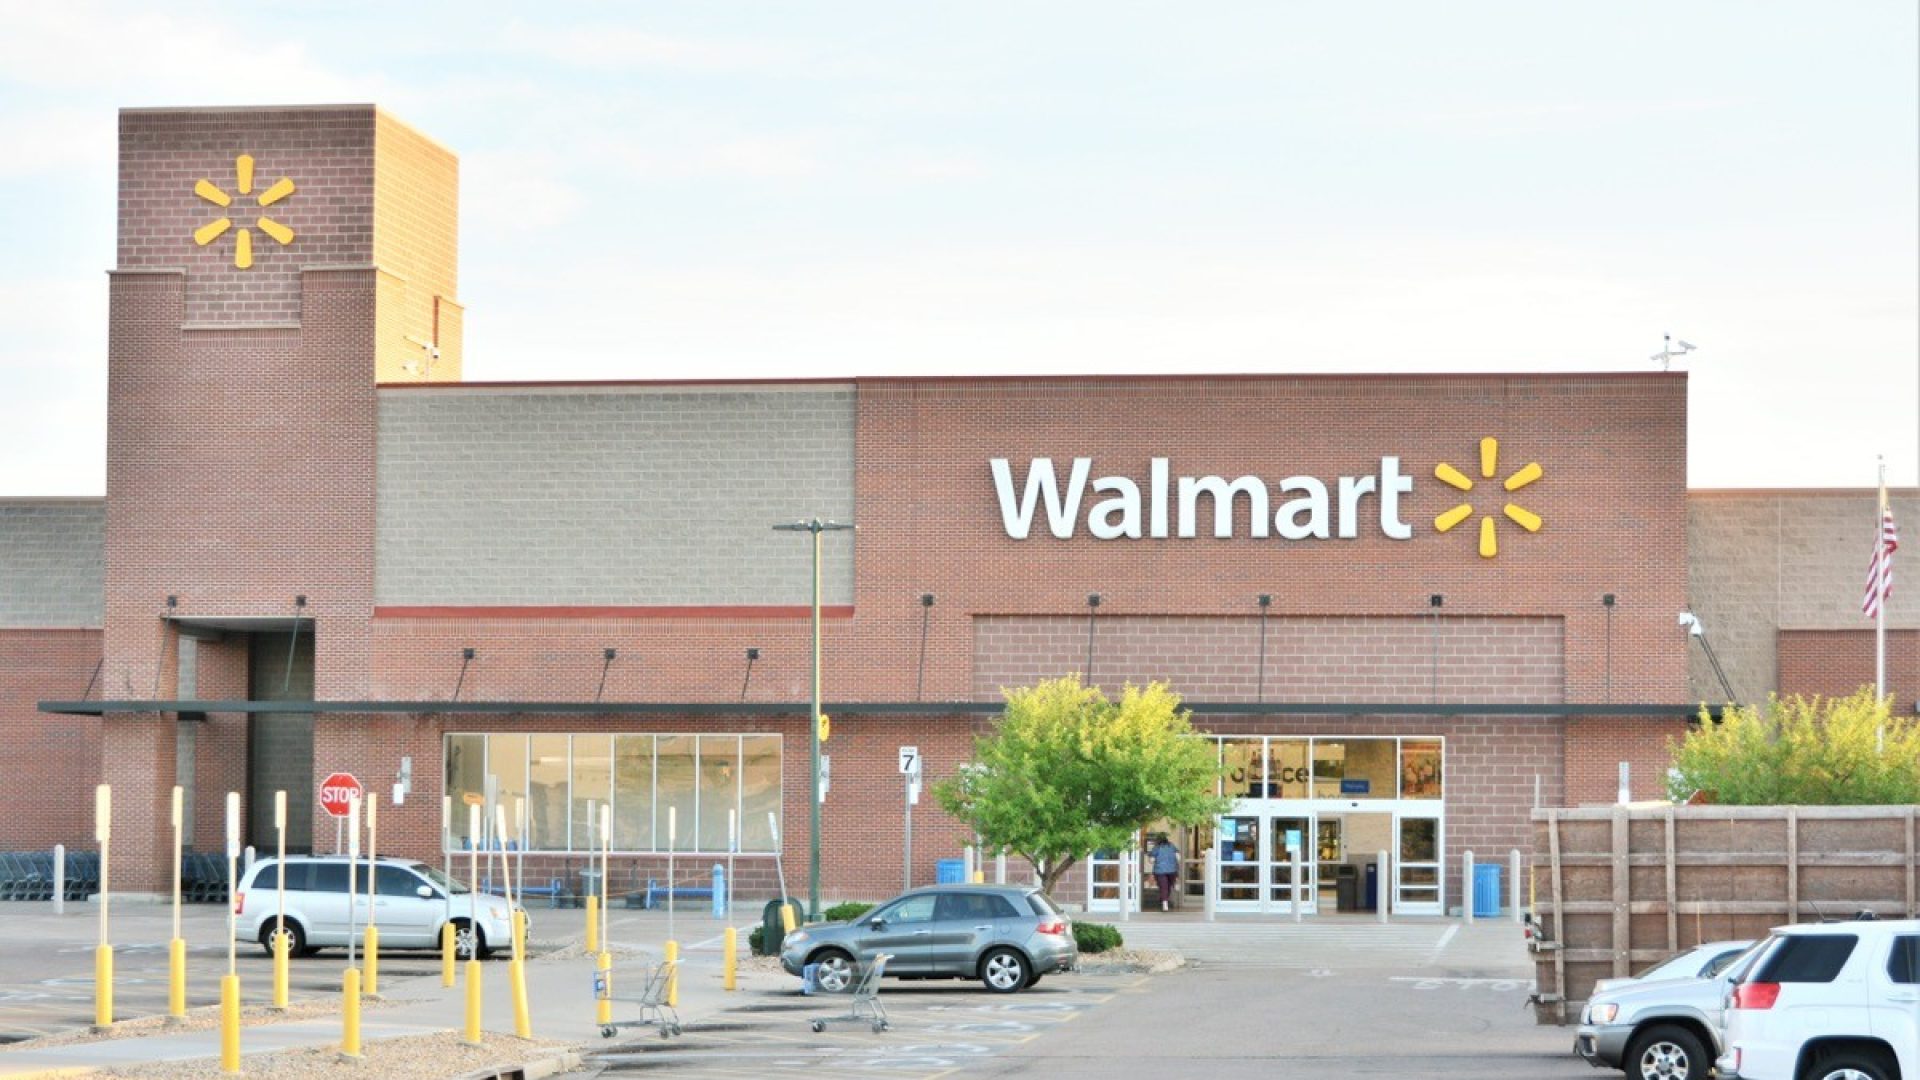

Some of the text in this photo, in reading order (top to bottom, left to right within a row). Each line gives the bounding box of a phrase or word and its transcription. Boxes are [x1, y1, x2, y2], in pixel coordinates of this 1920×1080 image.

[990, 456, 1413, 540] Walmart
[902, 754, 915, 771] 7
[322, 786, 359, 803] STOP
